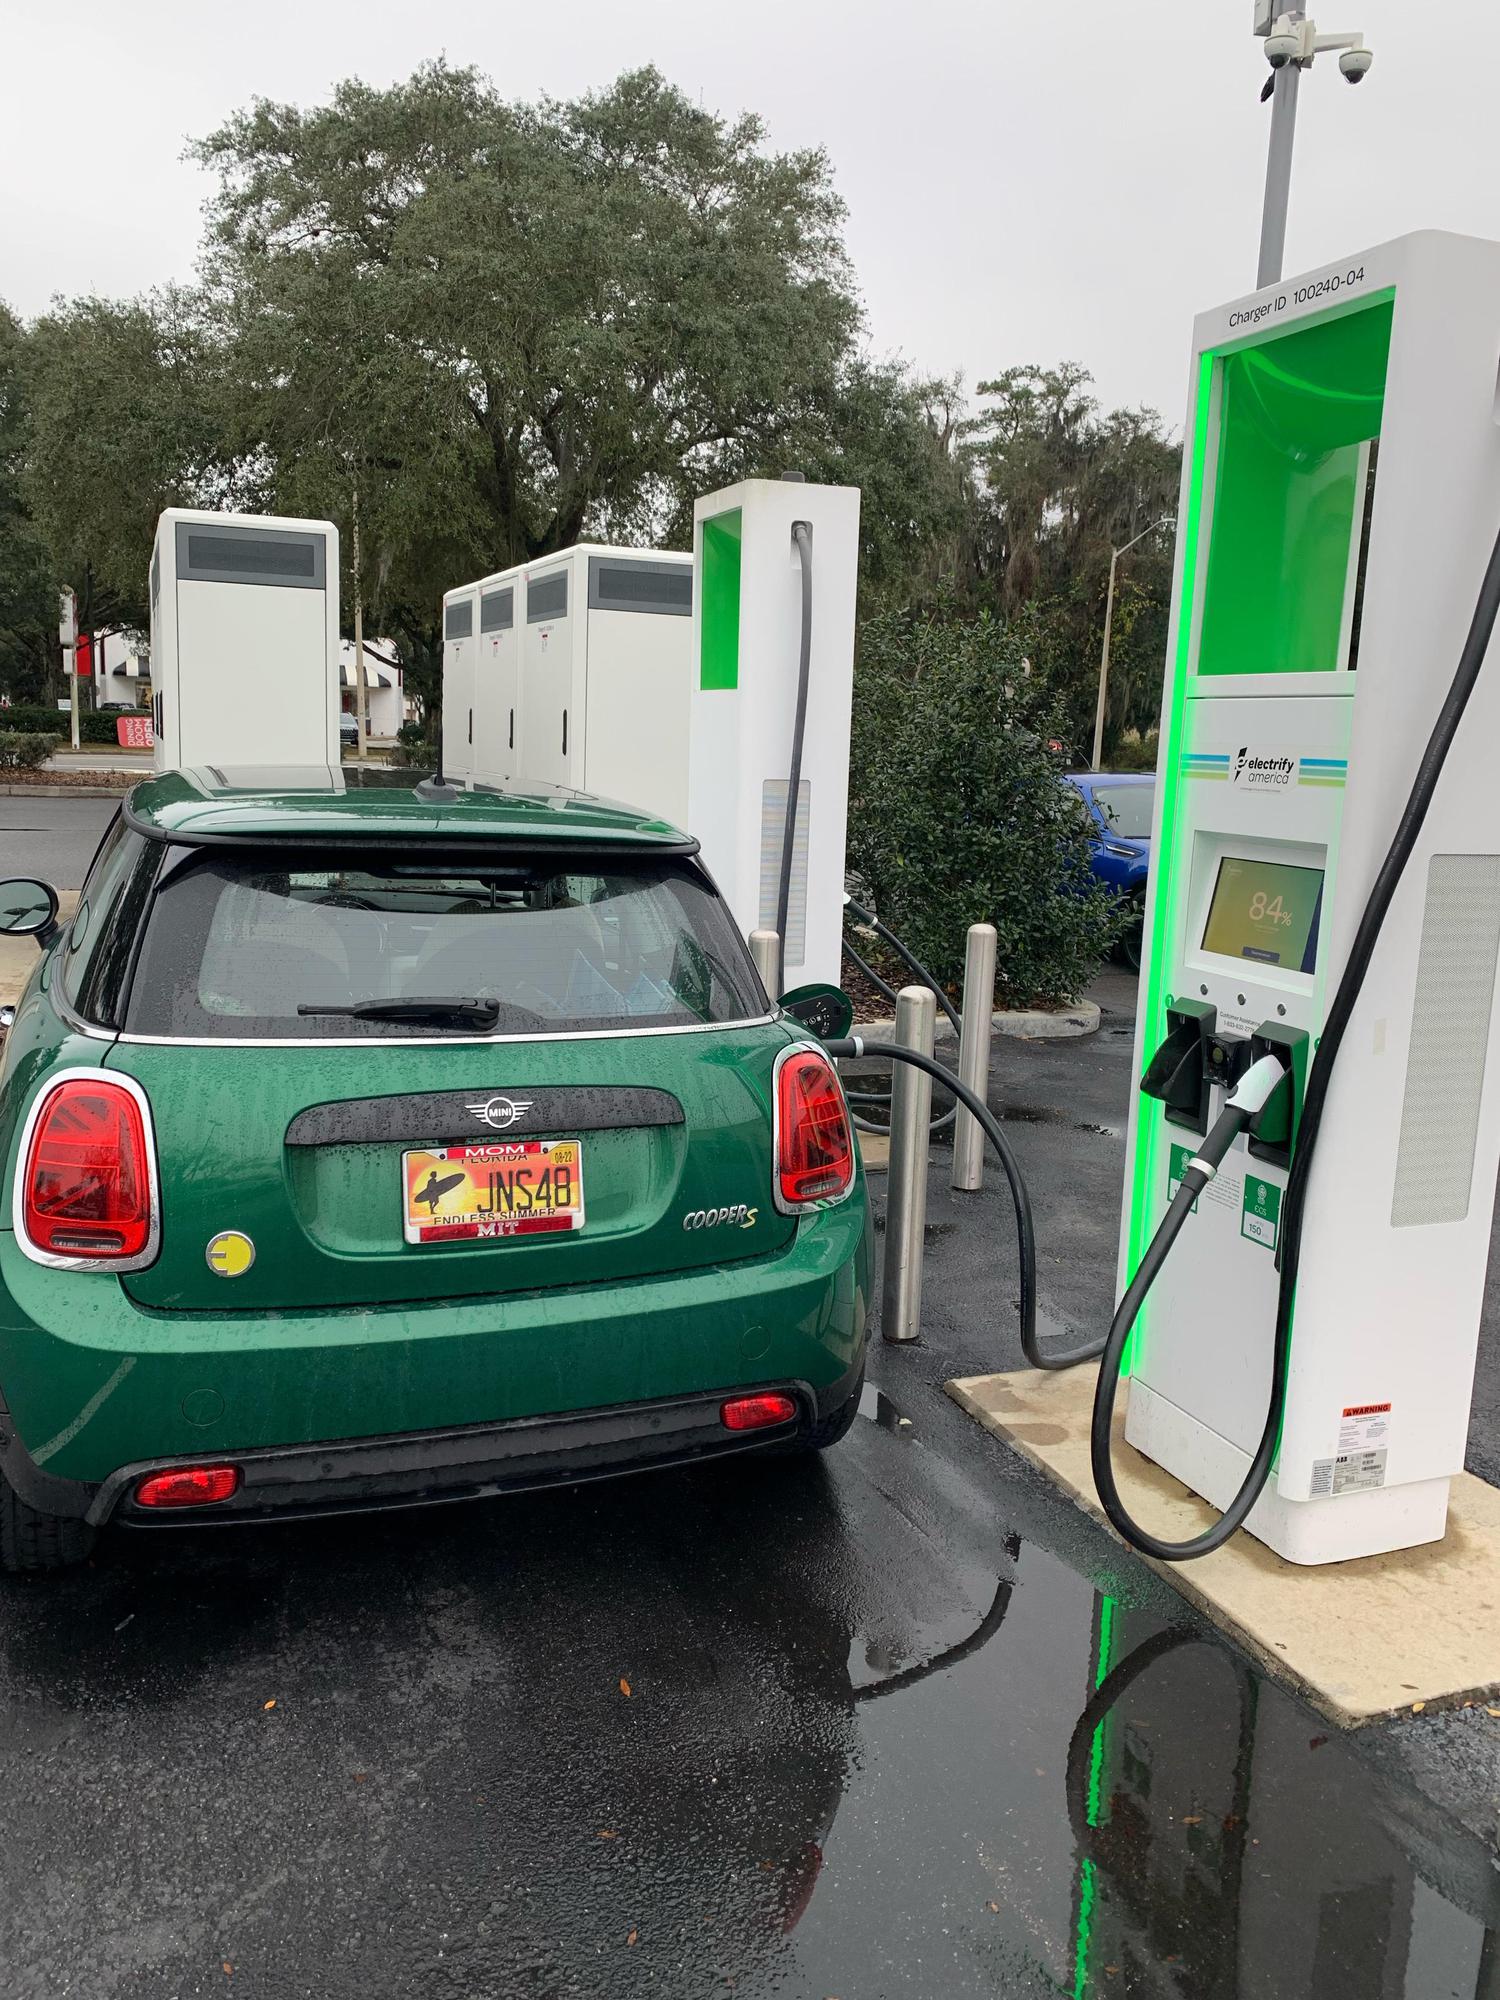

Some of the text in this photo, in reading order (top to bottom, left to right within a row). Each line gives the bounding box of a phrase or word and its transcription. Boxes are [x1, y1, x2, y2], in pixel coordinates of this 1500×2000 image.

[1229, 267, 1365, 327] Charger ID 100240-04
[126, 719, 136, 746] DINING
[134, 719, 145, 746] ROOM
[144, 718, 154, 747] OPEN
[1248, 757, 1294, 774] electrify
[1248, 772, 1289, 784] america
[1249, 891, 1293, 926] 84%
[489, 1108, 512, 1117] MINI
[465, 1144, 525, 1157] MOM
[477, 1166, 571, 1213] JNS48
[434, 1212, 495, 1225] ENDLESS
[500, 1208, 556, 1220] SUMMER
[683, 1204, 747, 1231] COOPER
[477, 1221, 519, 1237] MIT
[1248, 1223, 1262, 1236] 150
[1352, 1404, 1389, 1416] WARNING
